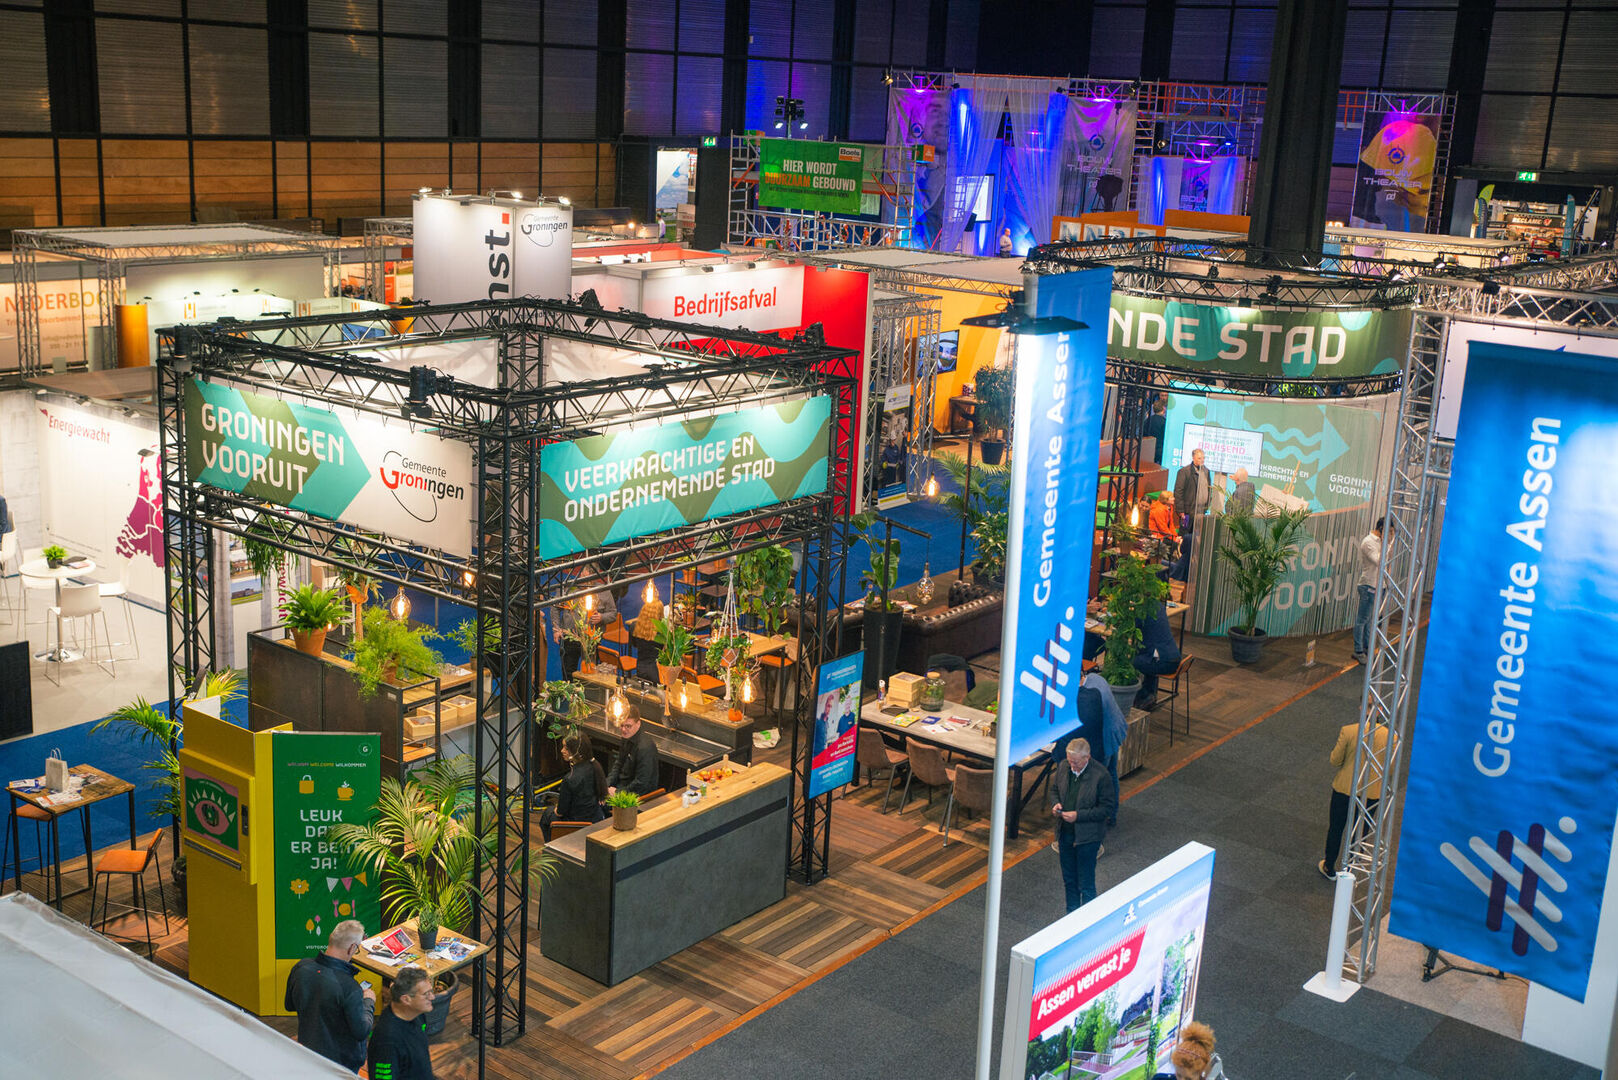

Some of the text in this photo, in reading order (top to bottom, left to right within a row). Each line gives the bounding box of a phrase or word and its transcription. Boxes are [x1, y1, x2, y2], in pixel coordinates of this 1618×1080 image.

[840, 147, 860, 156] Boels
[783, 159, 838, 176] HIER WORDT
[1067, 164, 1122, 175] THEATER
[1375, 168, 1412, 178] BOUW
[764, 171, 811, 188] DUURZAAM
[812, 176, 856, 192] GEBOUWD
[1363, 177, 1422, 189] THEATER
[520, 221, 568, 236] Groningen
[673, 286, 777, 318] Bedrijfsafval
[1217, 322, 1347, 365] STAD
[49, 415, 110, 444] Energiewacht
[201, 403, 344, 466] GRONINGEN
[202, 439, 308, 494] VOORUIT
[401, 457, 447, 478] Gemeente
[565, 435, 754, 493] VEERKRACHTIGE EN
[380, 466, 465, 500] Groningen
[564, 457, 775, 523] ONDERNEMENDE STAD
[1033, 434, 1062, 608] Gemeente
[1472, 416, 1562, 778] Gemeente Assen
[300, 809, 343, 822] LEUK
[291, 841, 312, 854] ER
[310, 857, 338, 870] JA!
[1036, 947, 1132, 1021] Assen verrast je
